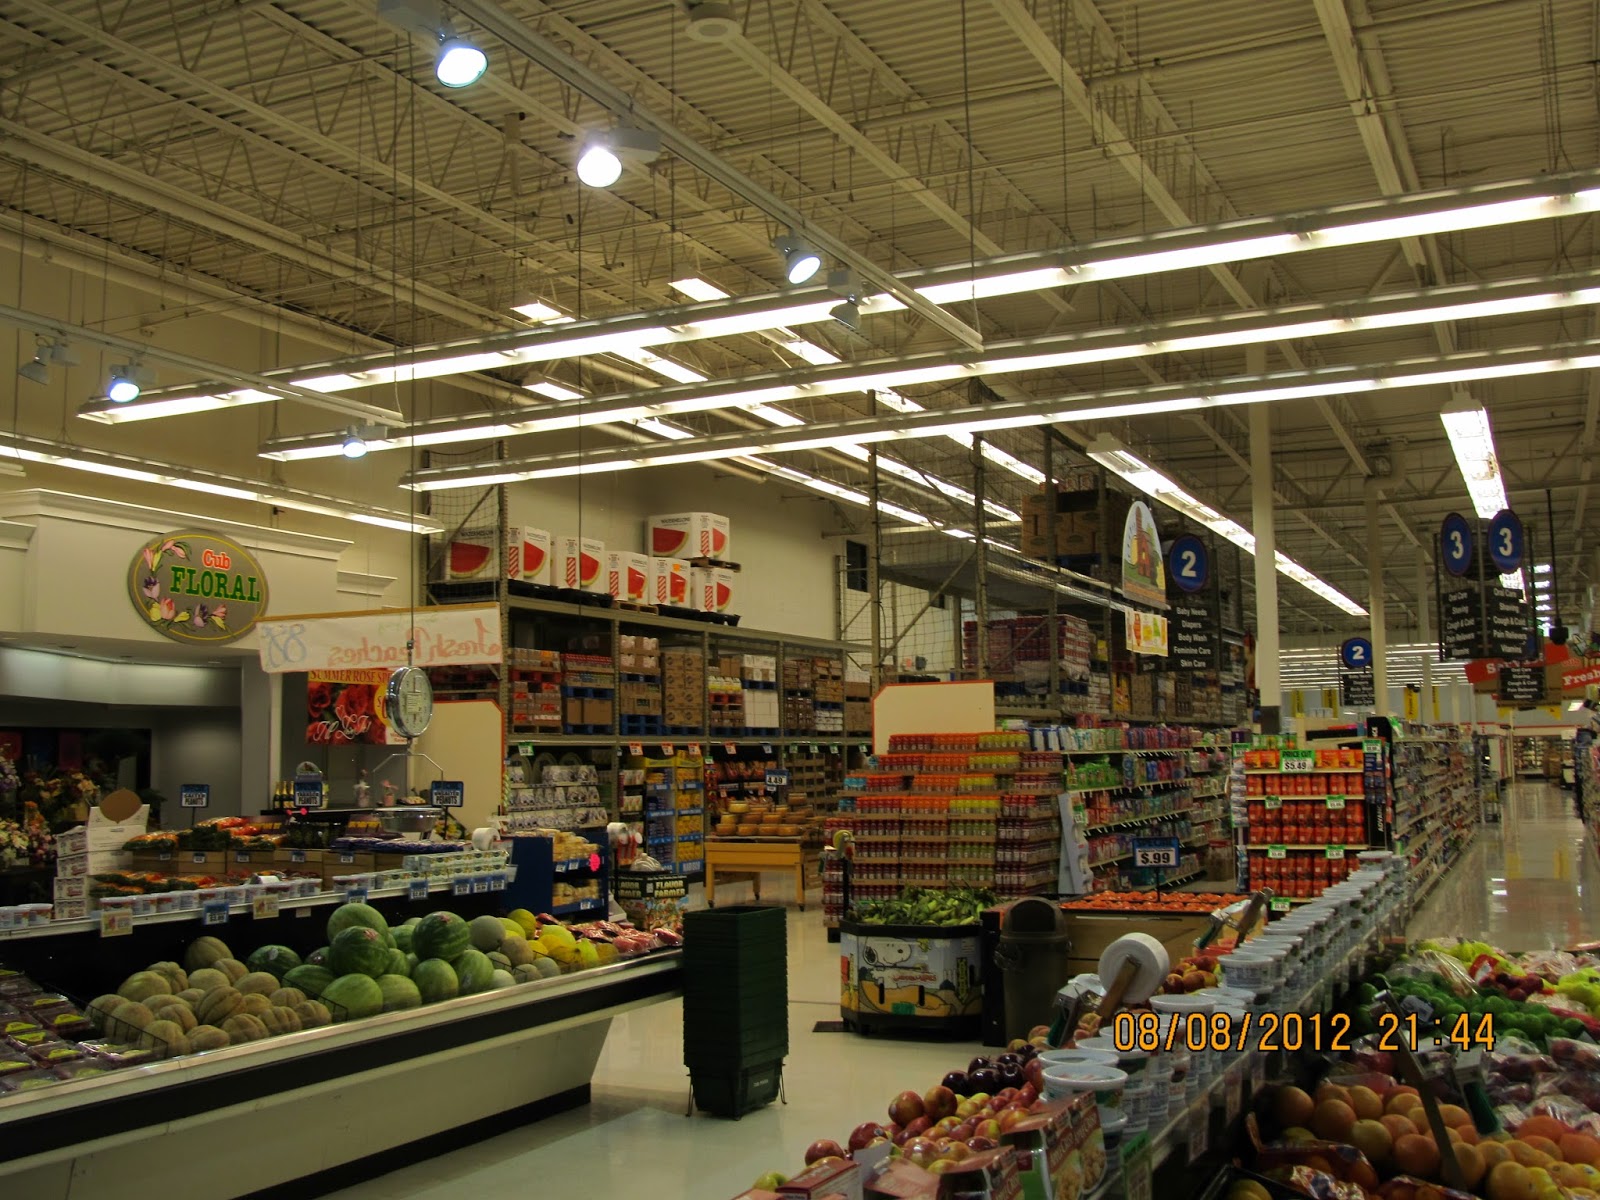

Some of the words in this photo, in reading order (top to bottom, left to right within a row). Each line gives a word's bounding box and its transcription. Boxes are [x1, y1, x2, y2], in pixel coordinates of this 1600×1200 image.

[1450, 531, 1463, 559] 3
[1499, 528, 1513, 556] 3
[202, 549, 231, 570] Cub
[1181, 550, 1197, 577] 2
[170, 565, 260, 602] FLORAL
[1505, 589, 1517, 598] Care
[1176, 607, 1190, 617] Baby
[1190, 607, 1207, 617] Needs
[1499, 603, 1519, 614] Shaving
[1181, 620, 1202, 630] Diapers
[1493, 616, 1510, 627] Cough
[1515, 618, 1526, 626] Cold
[1178, 633, 1192, 643] Body
[1192, 633, 1207, 642] Wash
[1493, 630, 1504, 638] Pain
[1505, 631, 1527, 640] Relievers
[1174, 646, 1199, 655] Feminine
[1200, 647, 1211, 655] Care
[1352, 645, 1364, 659] 2
[1180, 659, 1193, 667] Skin
[1194, 660, 1206, 668] Care
[311, 669, 351, 681] SUMMER
[354, 670, 375, 683] ROSE
[1285, 761, 1307, 770] $5.49
[1141, 852, 1170, 865] $.99
[655, 880, 684, 889] FLAVOR
[654, 888, 686, 897] FARMER
